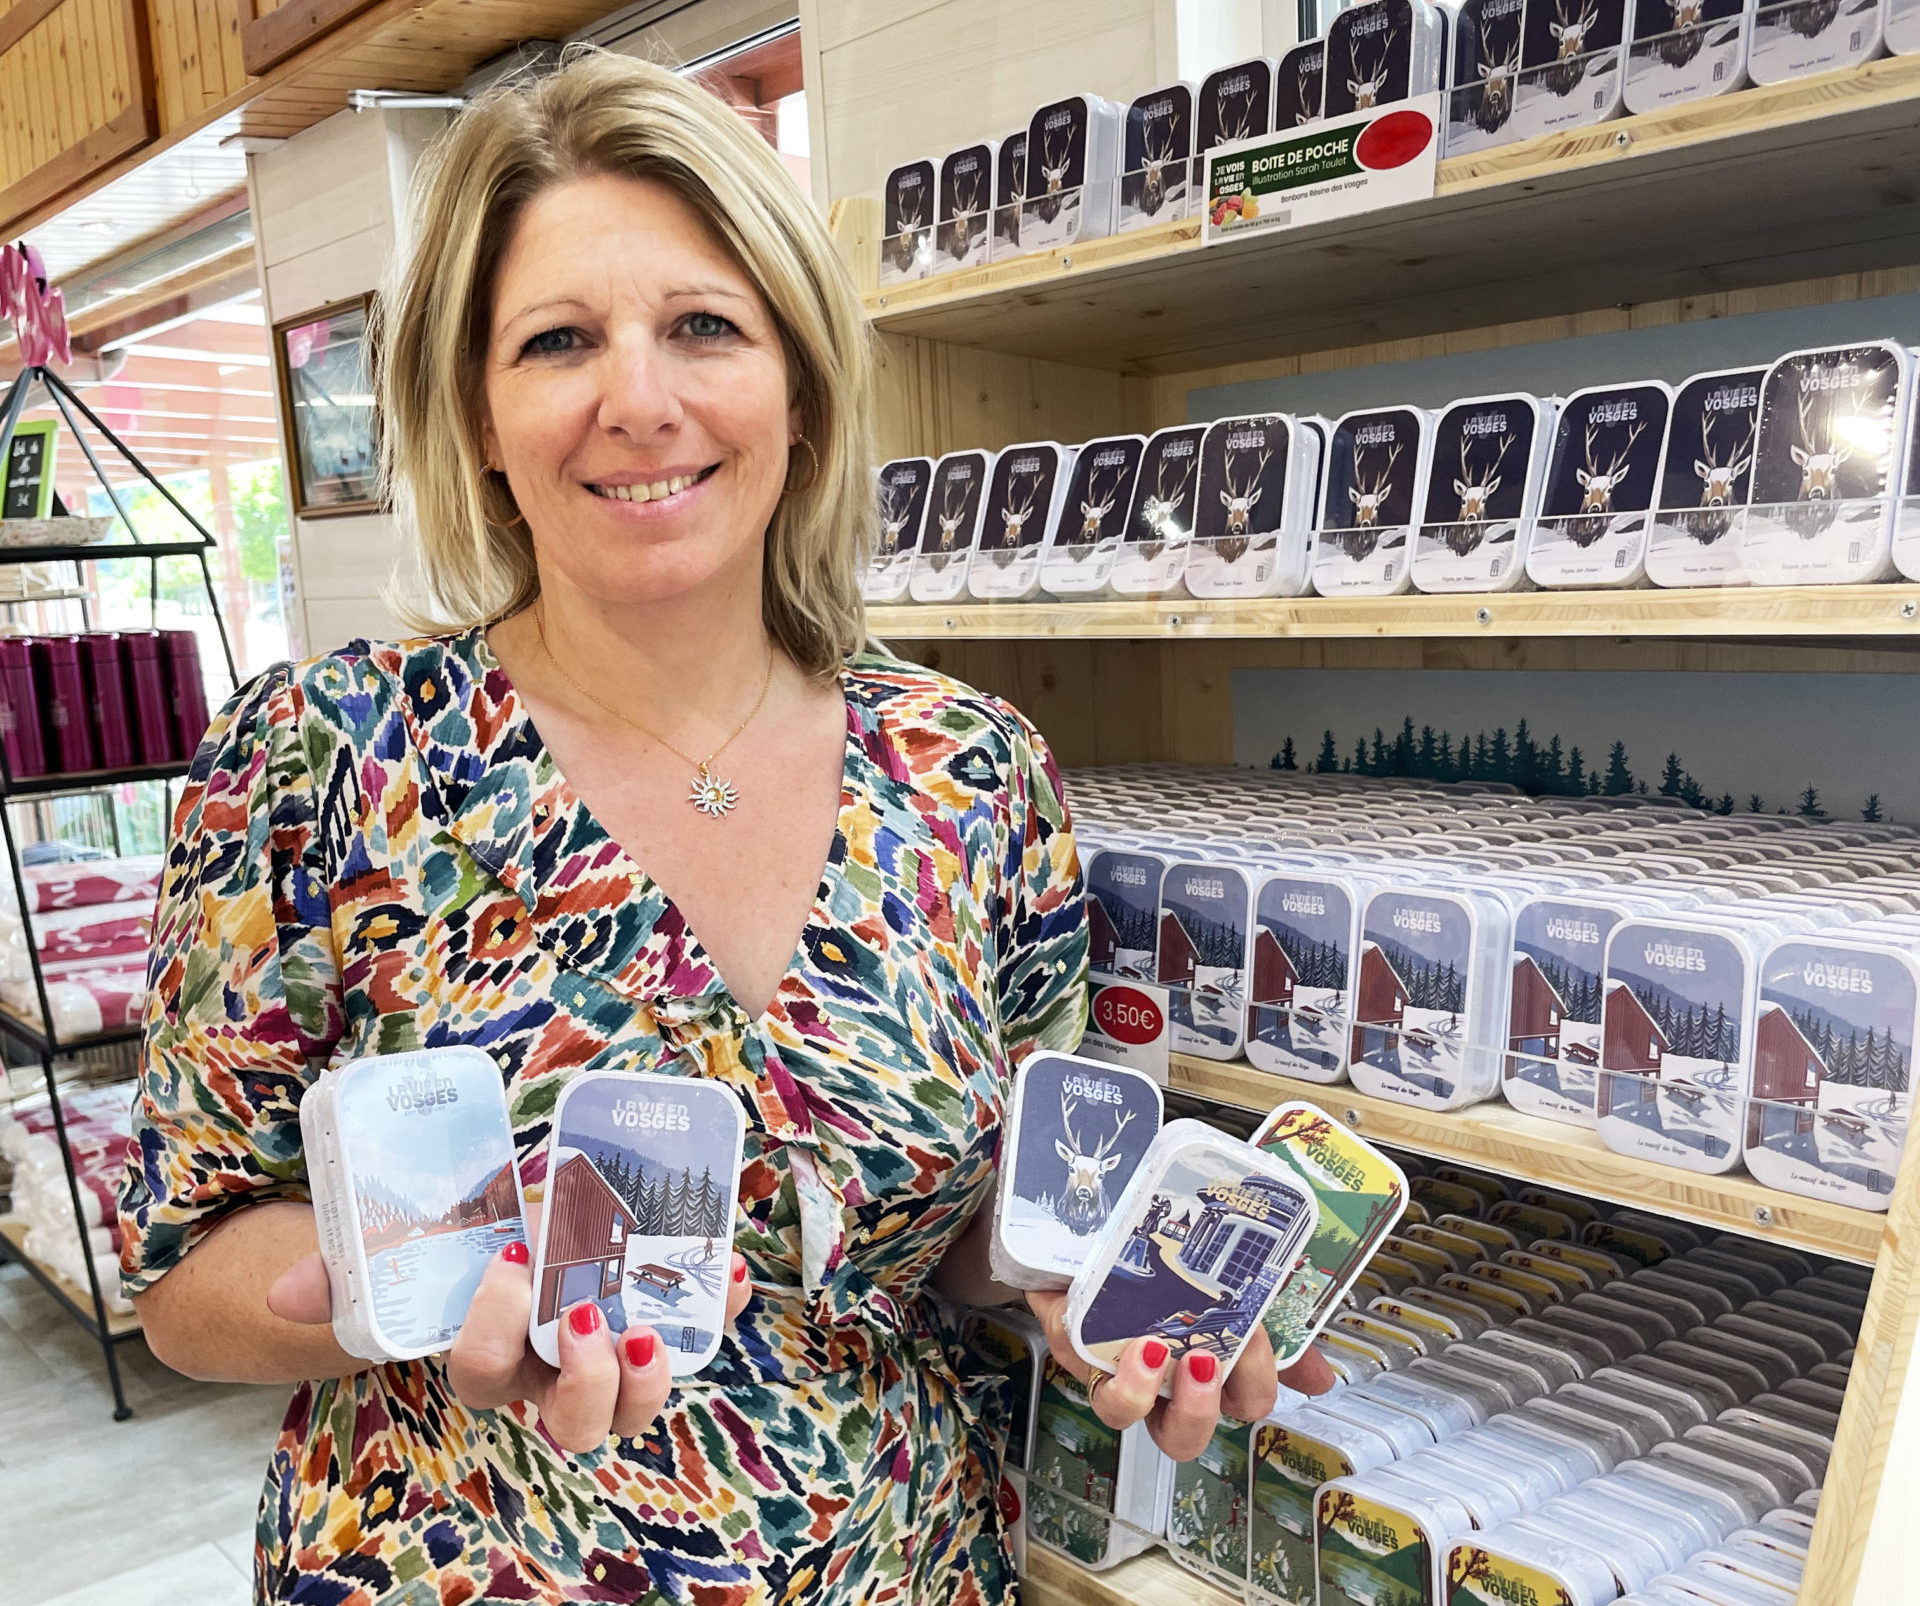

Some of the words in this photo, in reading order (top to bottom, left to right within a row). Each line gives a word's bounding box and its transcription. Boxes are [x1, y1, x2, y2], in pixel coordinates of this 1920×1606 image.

[1482, 0, 1522, 20] VOSGES
[1351, 19, 1388, 37] VOSGES
[1299, 59, 1323, 74] VOSG
[1218, 81, 1250, 96] VOSGES
[1144, 106, 1173, 120] VOSGES
[1045, 116, 1071, 130] VOSGES
[1252, 154, 1285, 173] BOITE
[1288, 149, 1303, 165] DE
[1306, 139, 1348, 161] POCHE
[1216, 165, 1225, 176] JE
[1226, 161, 1245, 173] VOIS
[1252, 170, 1293, 185] illustration
[1295, 163, 1319, 176] Sarah
[1224, 175, 1235, 183] VIE
[1800, 374, 1860, 392] VOSGES
[1705, 395, 1757, 411] VOSGES
[1589, 409, 1637, 424] VOSGES
[1463, 422, 1506, 435] VOSGES
[1226, 437, 1264, 449] VOSGES
[1356, 432, 1394, 444] VOSGES
[1162, 446, 1194, 457] VOSGES
[1011, 463, 1040, 473] VOSGES
[1094, 456, 1125, 466] VOSGES
[1110, 872, 1146, 885] VOSGES
[1185, 884, 1224, 898] VOSGES
[1283, 902, 1324, 915] VOSGES
[1393, 916, 1441, 933] VOSGES
[1547, 926, 1599, 944] VOSGES
[1645, 952, 1706, 971] VOSGES
[1803, 971, 1872, 994] VOSGES
[1103, 1001, 1154, 1029] 3,50€
[386, 1088, 458, 1111] VOSGES
[1062, 1081, 1123, 1105] VOSGES
[612, 1110, 691, 1131] VOSGES
[1306, 1144, 1363, 1192] VOSGES
[1207, 1186, 1270, 1220] VOSGES
[1281, 1454, 1327, 1482] VOSGES
[1348, 1520, 1399, 1550] VOSGES
[1481, 1579, 1538, 1606] VOSGES
